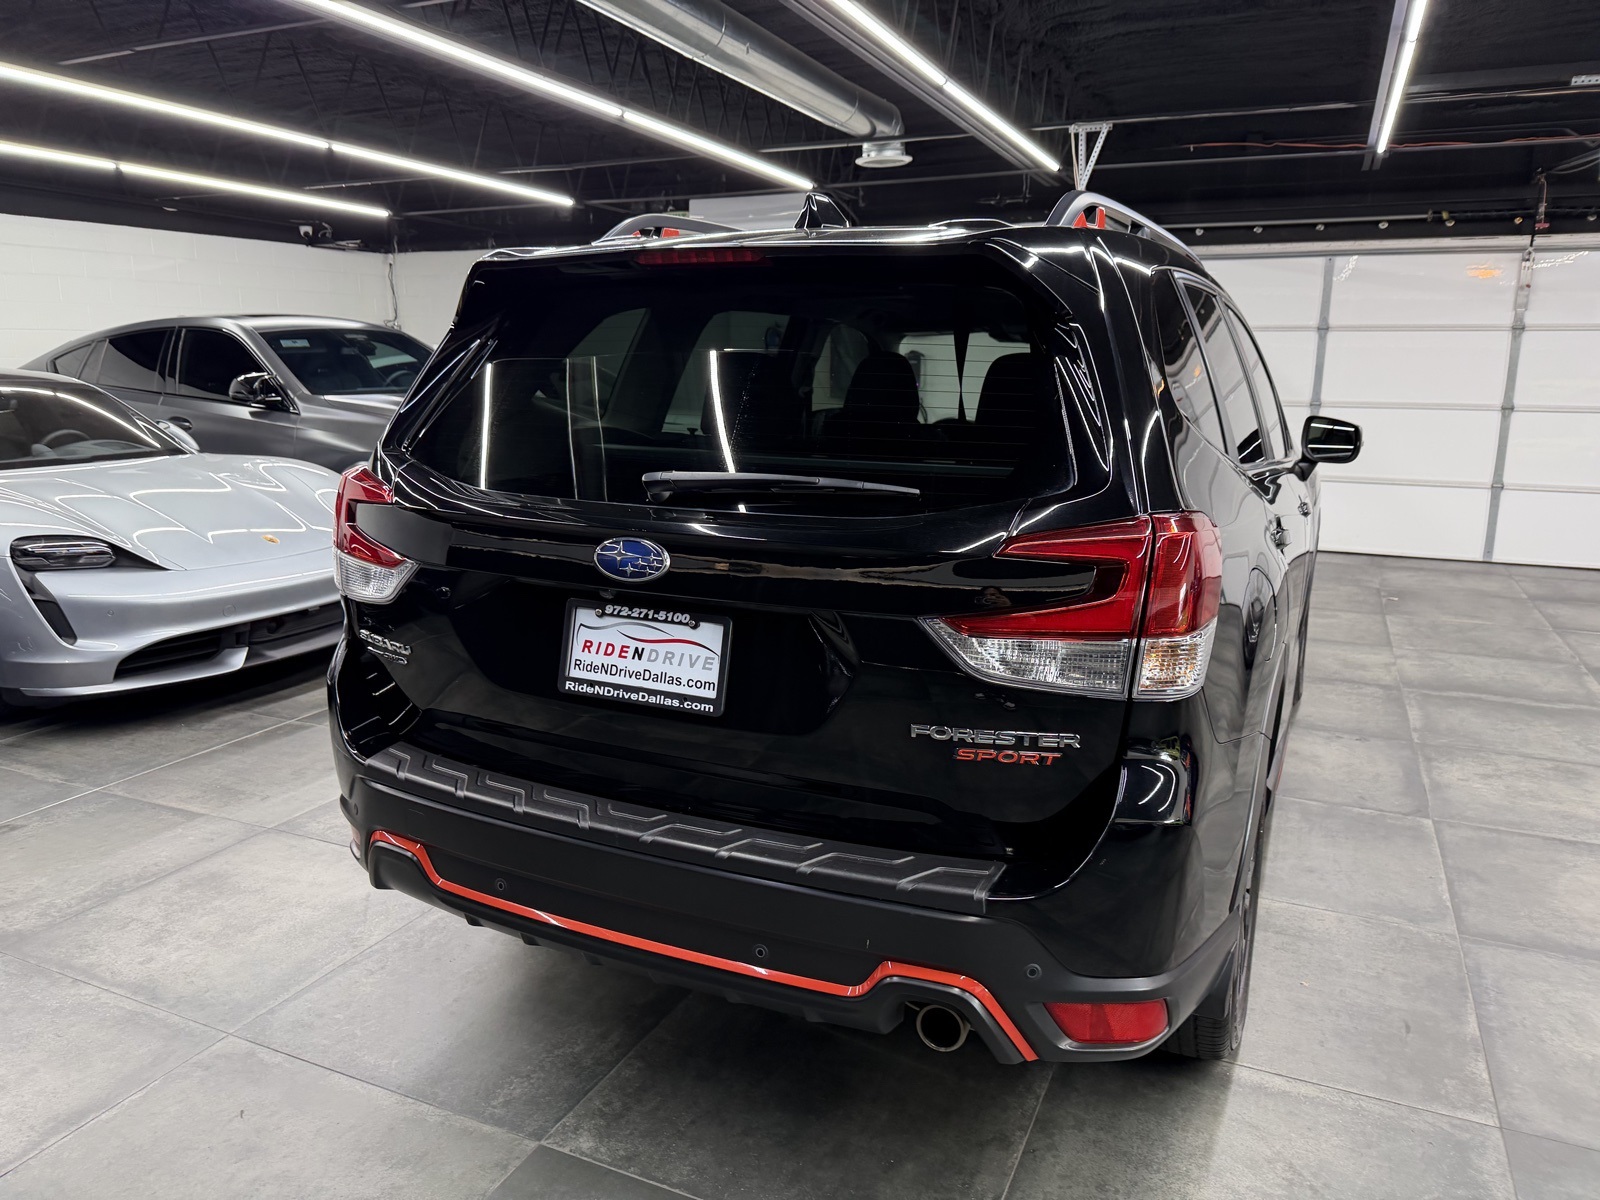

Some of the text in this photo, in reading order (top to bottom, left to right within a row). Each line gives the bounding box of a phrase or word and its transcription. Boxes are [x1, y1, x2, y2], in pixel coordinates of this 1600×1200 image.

[605, 605, 690, 624] 972-271-5100
[359, 629, 412, 656] SUBARU
[581, 639, 716, 671] RIDENDRIVE
[574, 658, 716, 692] RideNDriveDallas.com
[565, 681, 714, 713] RideNDriveDallas.com
[910, 723, 1081, 749] FORESTER
[955, 748, 1063, 766] SPORT
